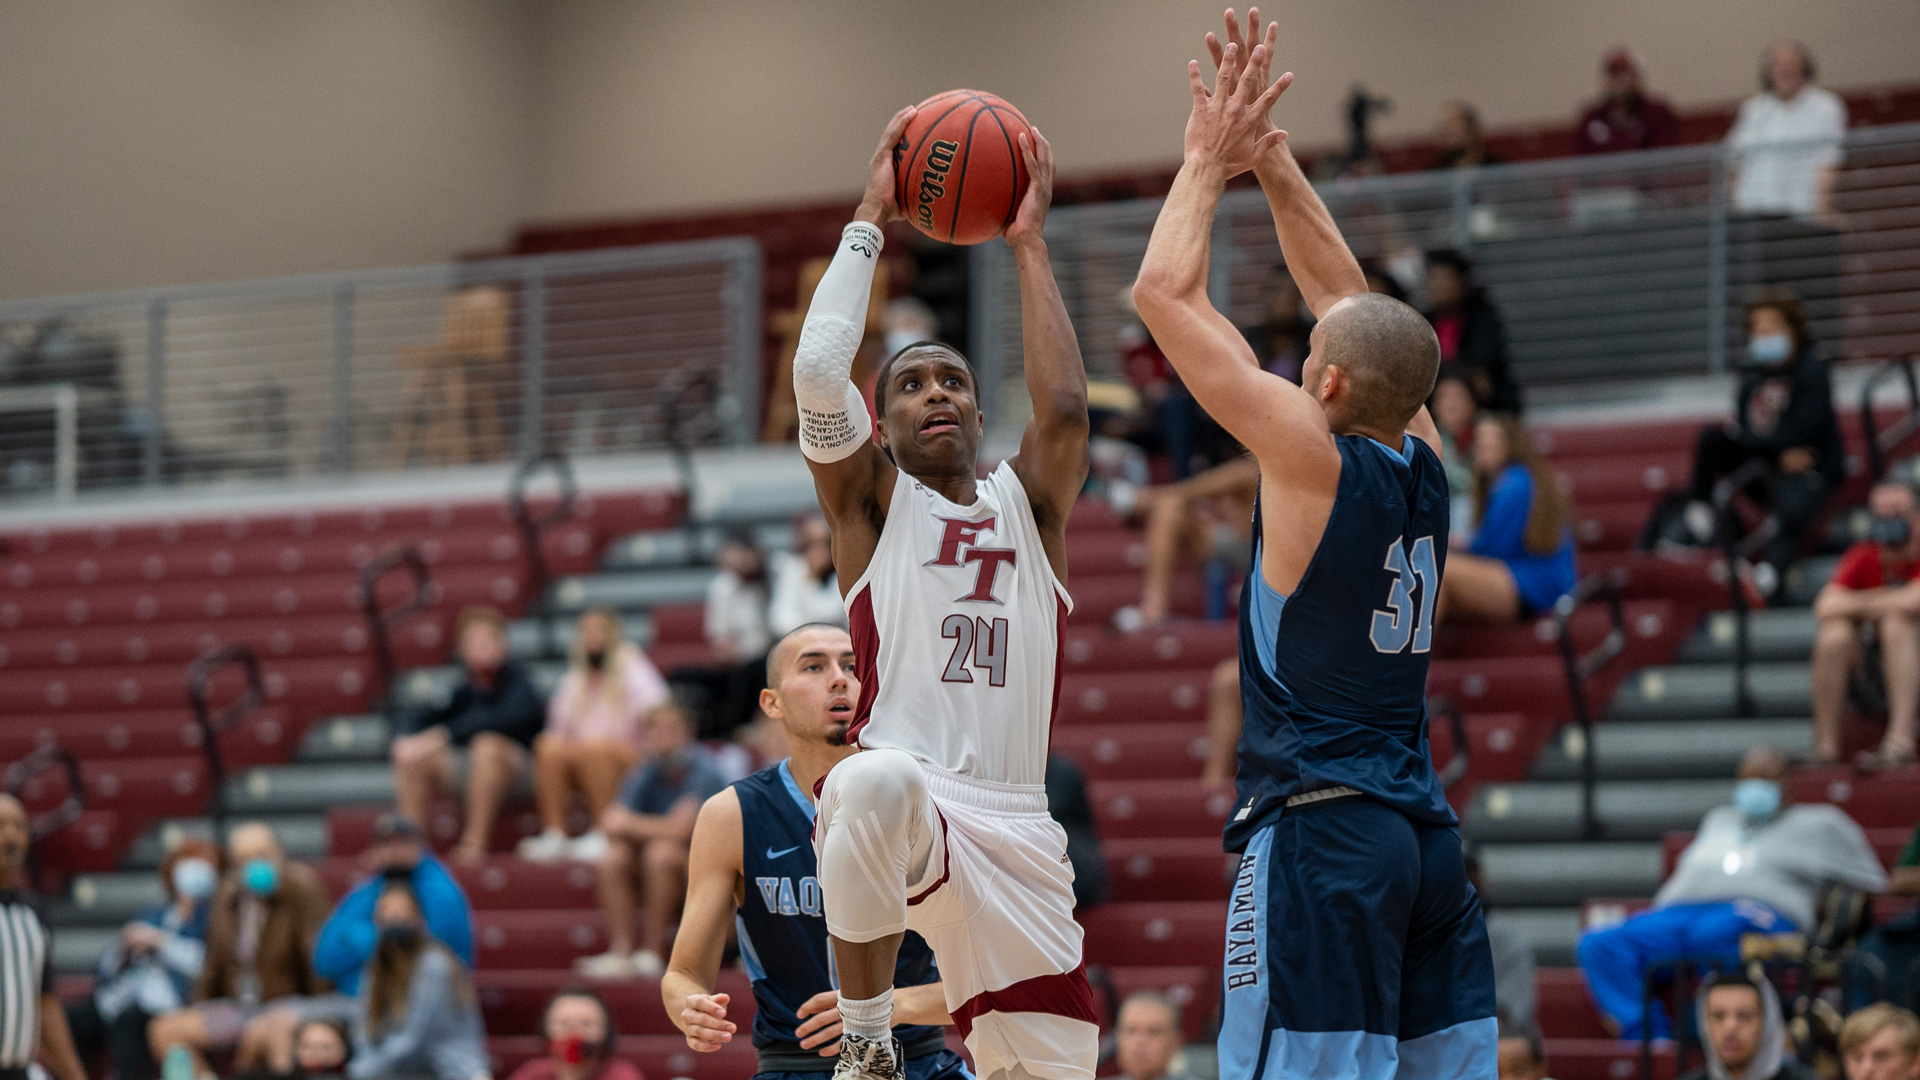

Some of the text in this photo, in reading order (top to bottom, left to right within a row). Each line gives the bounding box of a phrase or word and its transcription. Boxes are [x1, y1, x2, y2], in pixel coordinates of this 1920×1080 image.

[917, 139, 959, 231] Wilson
[838, 416, 849, 425] NO
[806, 424, 815, 432] GO
[833, 424, 849, 433] YOU
[839, 425, 856, 438] YOUR
[818, 434, 838, 442] LIMIT
[820, 440, 842, 449] ONLY
[922, 513, 1016, 606] FT
[1369, 535, 1437, 653] 31
[941, 614, 1008, 687] 24
